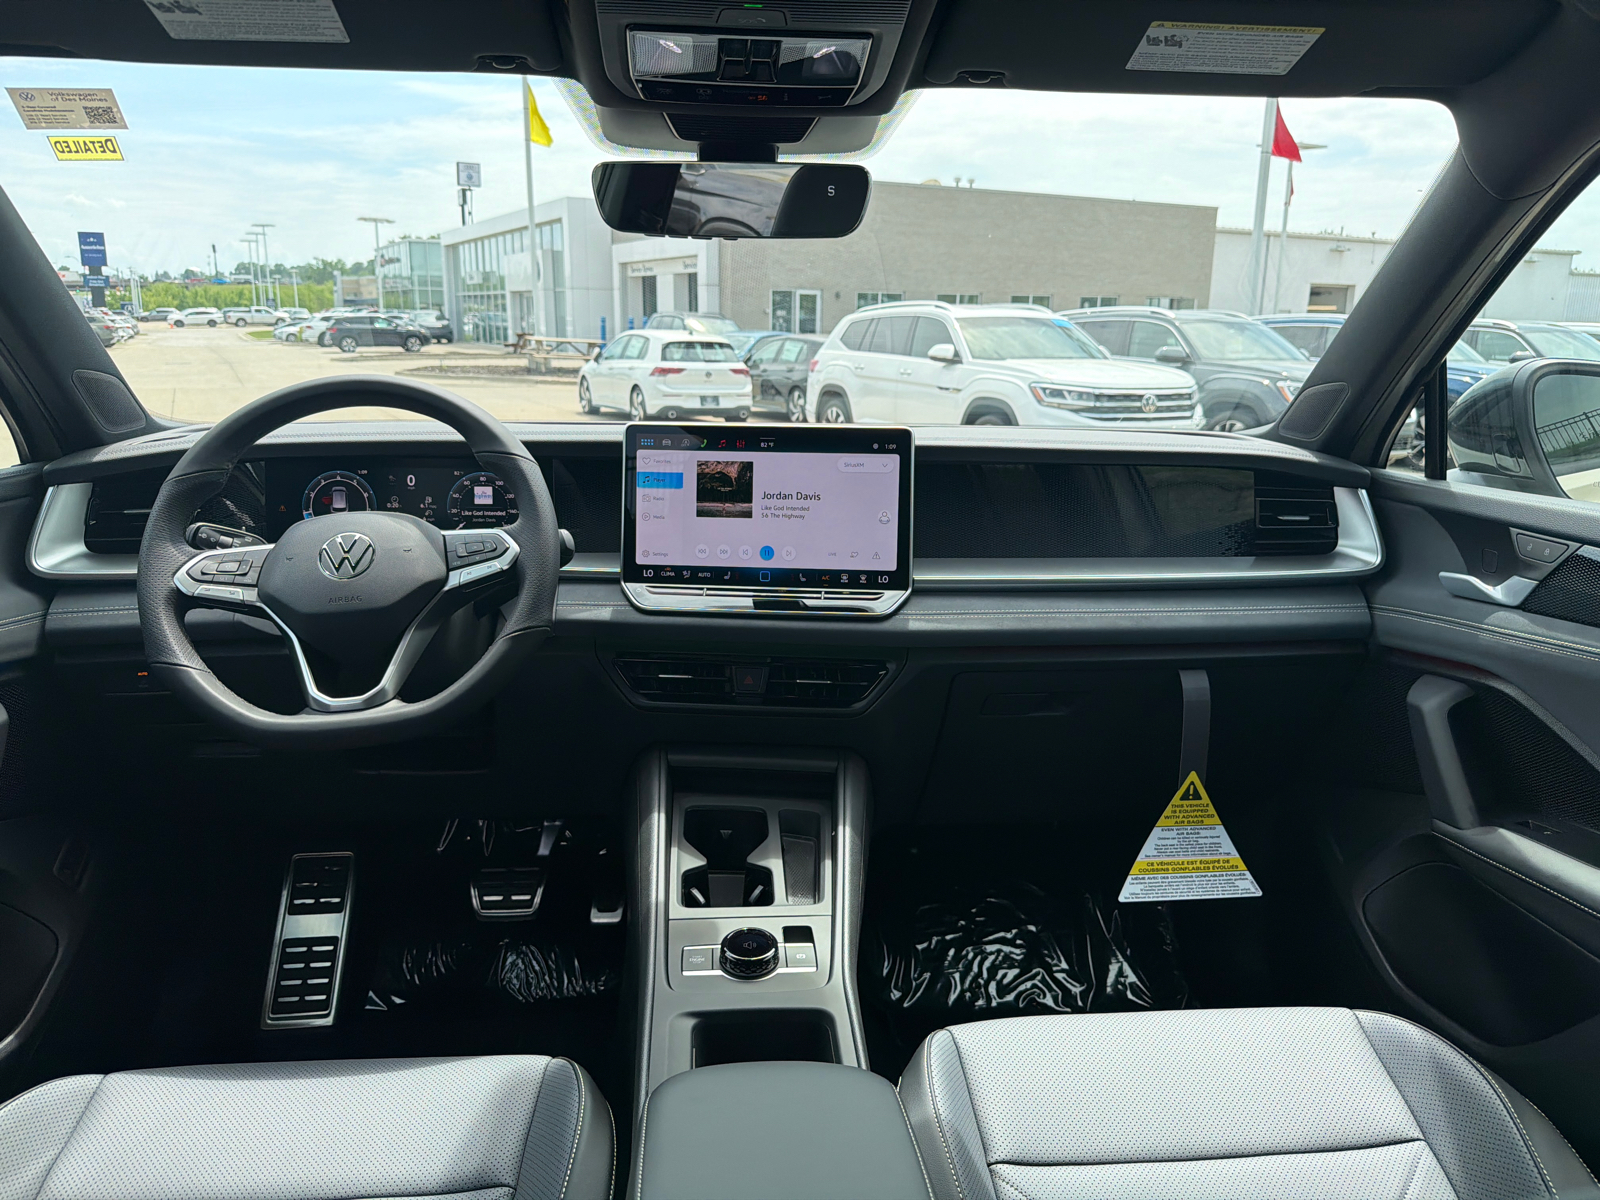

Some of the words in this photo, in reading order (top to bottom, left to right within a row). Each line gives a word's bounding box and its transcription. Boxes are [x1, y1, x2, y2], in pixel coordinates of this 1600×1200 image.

[827, 185, 836, 197] S
[406, 474, 416, 486] 0
[761, 490, 793, 500] Jordan
[796, 491, 821, 501] Davis
[643, 569, 654, 577] LO
[878, 575, 889, 583] LO
[328, 595, 363, 604] AIRBAG
